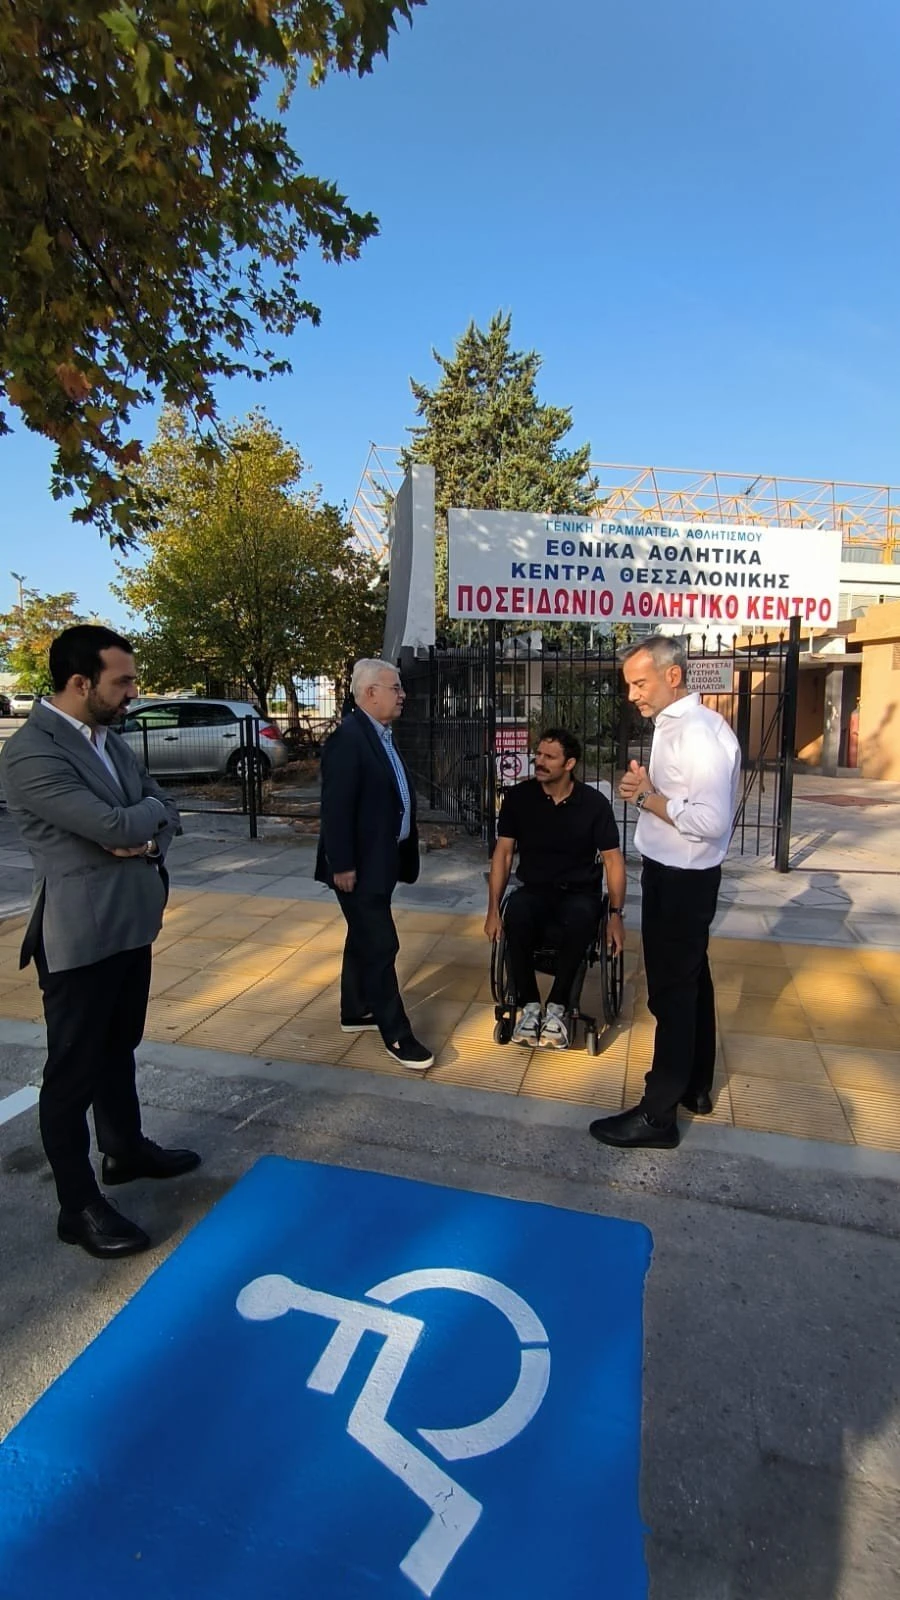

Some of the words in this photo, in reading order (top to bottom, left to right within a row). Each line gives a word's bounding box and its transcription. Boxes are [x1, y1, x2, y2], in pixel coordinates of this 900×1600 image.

[546, 520, 593, 533] ΓΕΝΙΚΗ
[601, 523, 680, 538] ΓΡΑΜΜΑΤΕΙΑ
[686, 529, 762, 542] ΑΘΛΗΤΙΣΜΟΥ
[546, 539, 635, 559] ΕΘΝΙΚΑ
[648, 545, 762, 565] ΑΘΛΗΤΙΚΑ
[511, 562, 605, 582] ΚΕΝΤΡΑ
[620, 567, 790, 588] ΘΕΣΣΑΛΟΝΙΚΗΣ
[457, 585, 614, 616] ΠΟΣΕΙΔΩΝΙΟ
[621, 591, 739, 620] ΑΘΛΗΤΙΚΟ
[747, 595, 831, 621] ΚΕΝΤΡΟ
